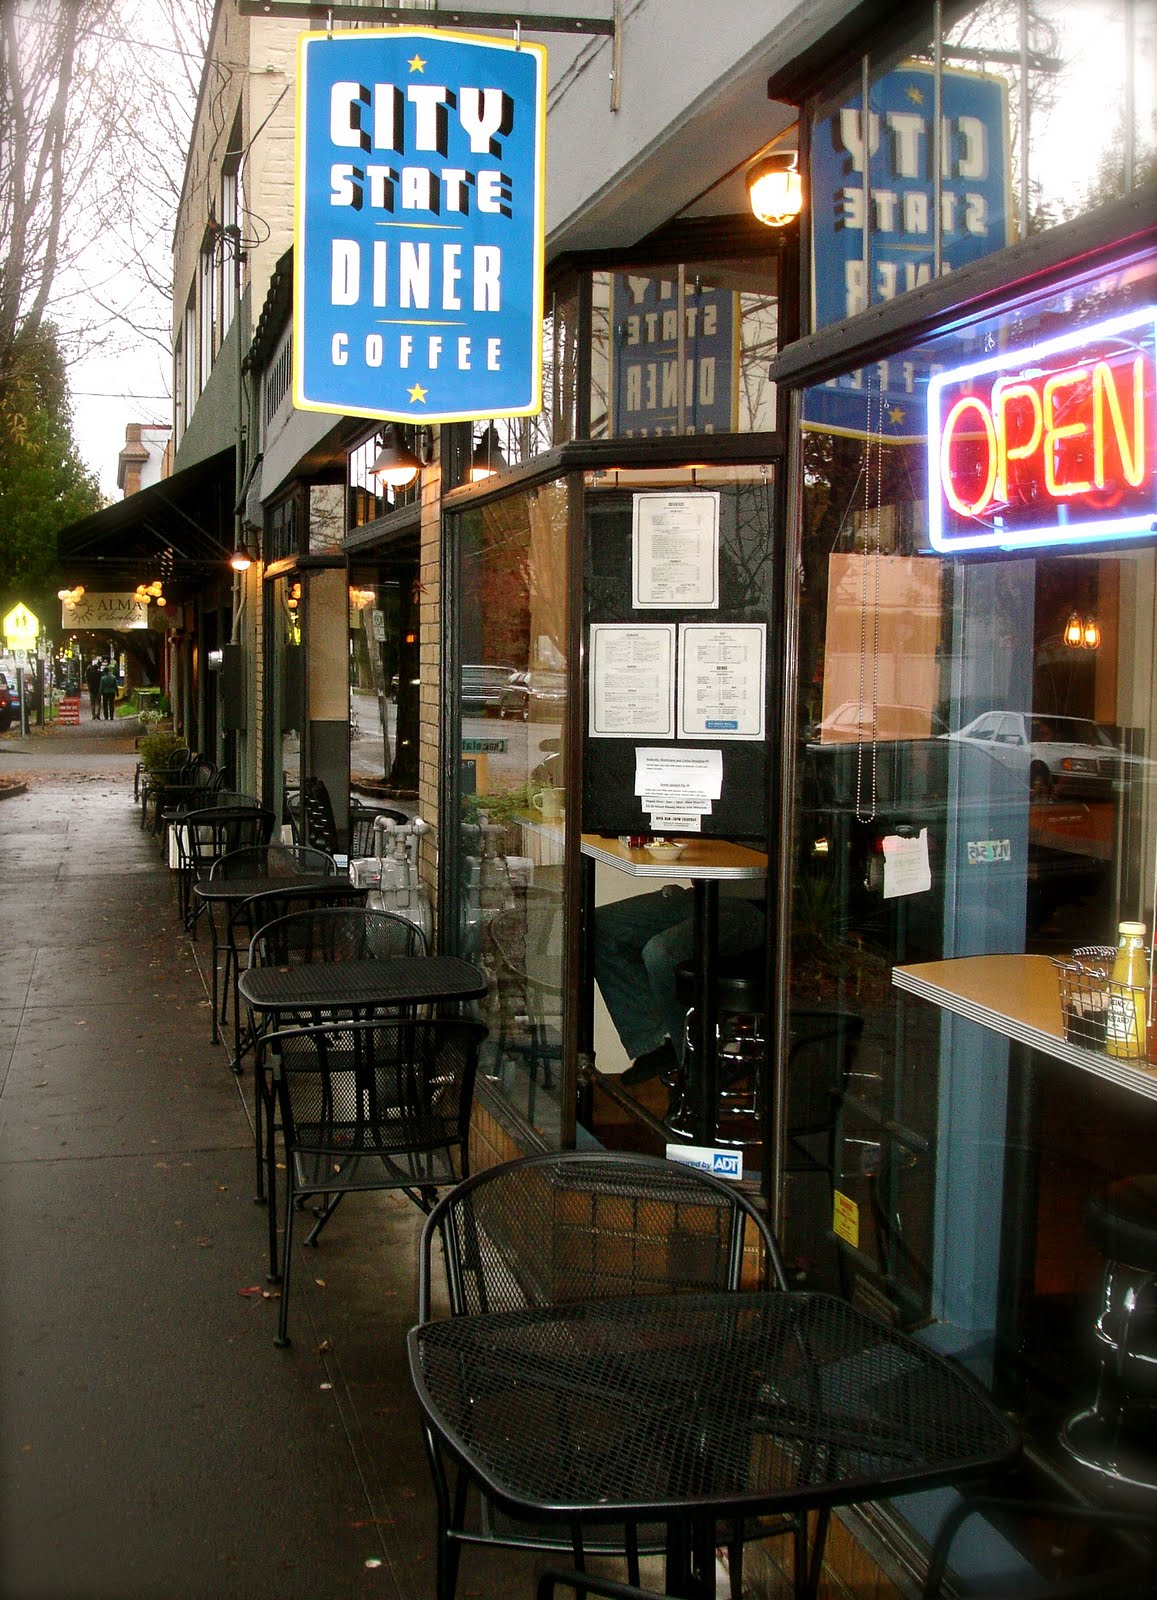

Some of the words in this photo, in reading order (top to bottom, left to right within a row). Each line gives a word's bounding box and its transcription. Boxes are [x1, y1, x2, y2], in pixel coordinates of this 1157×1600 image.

[330, 81, 512, 159] CITY
[330, 164, 512, 218] STATE
[331, 238, 501, 312] DINER
[331, 332, 502, 371] COFFEE
[940, 355, 1144, 516] OPEN
[98, 598, 143, 611] ALMA
[701, 1161, 712, 1170] by
[714, 1156, 738, 1172] ADT
